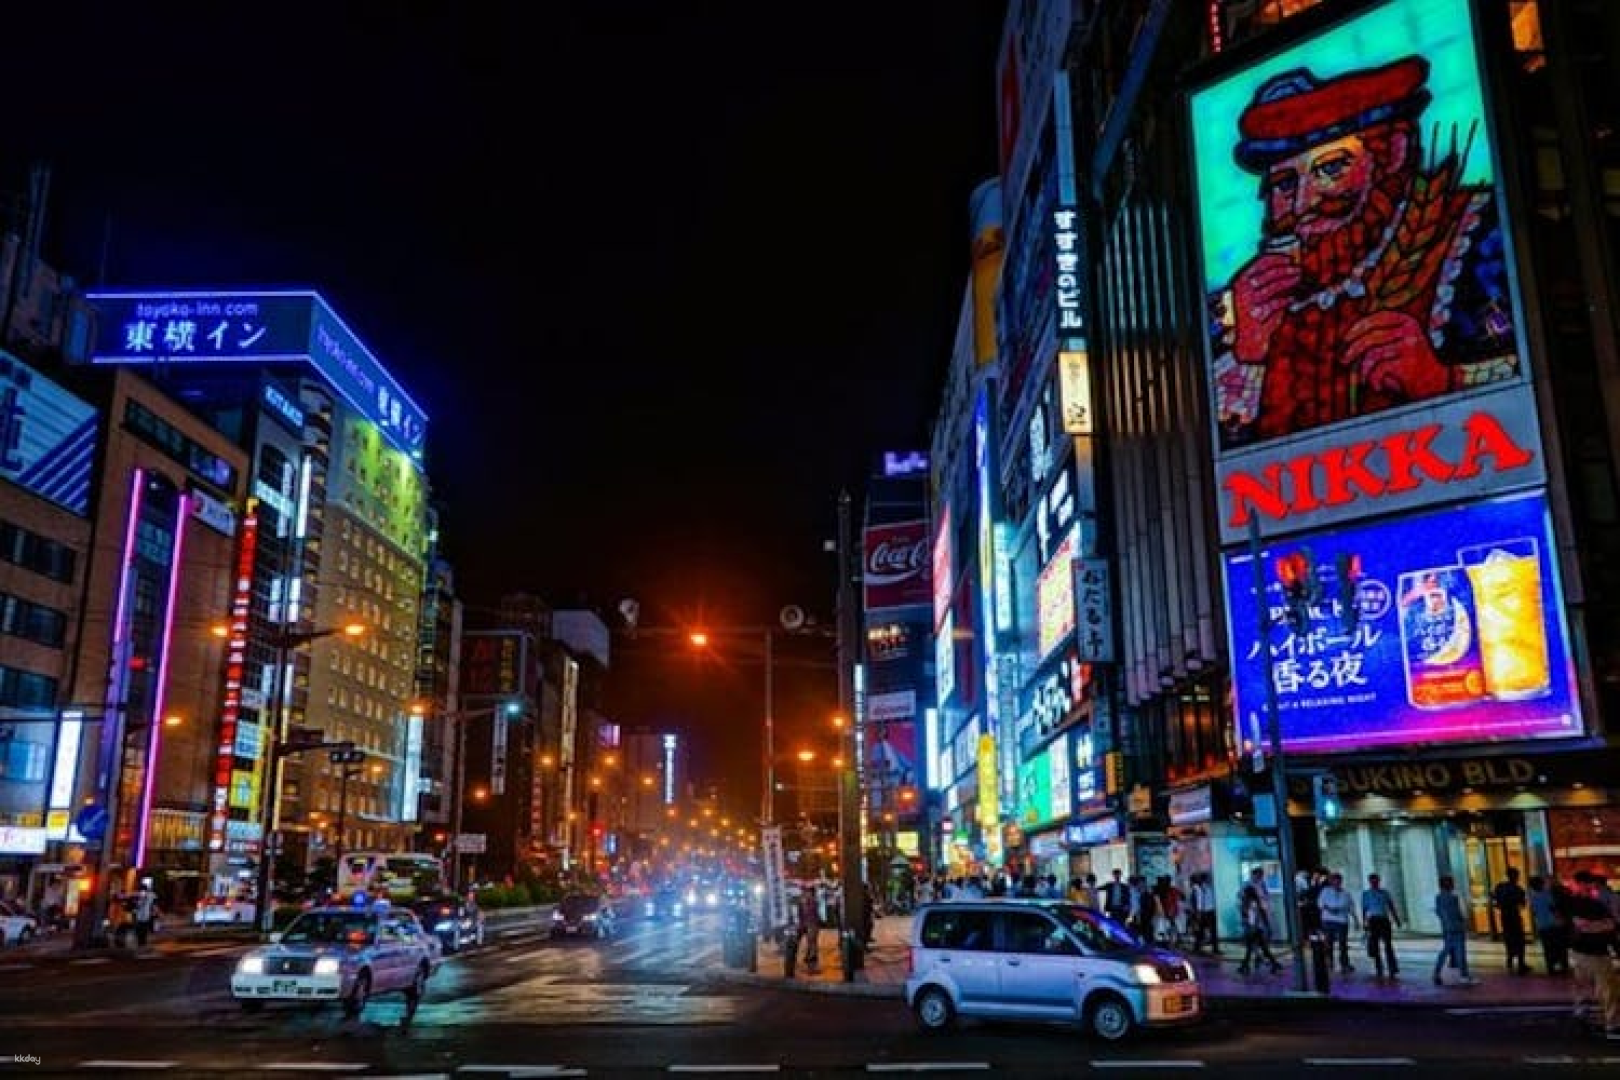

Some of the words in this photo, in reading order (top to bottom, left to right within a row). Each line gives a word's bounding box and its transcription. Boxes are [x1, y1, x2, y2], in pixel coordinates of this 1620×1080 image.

[1053, 209, 1083, 330] すすきのビル
[125, 319, 267, 352] 東横イン
[1222, 410, 1535, 528] NIKKA
